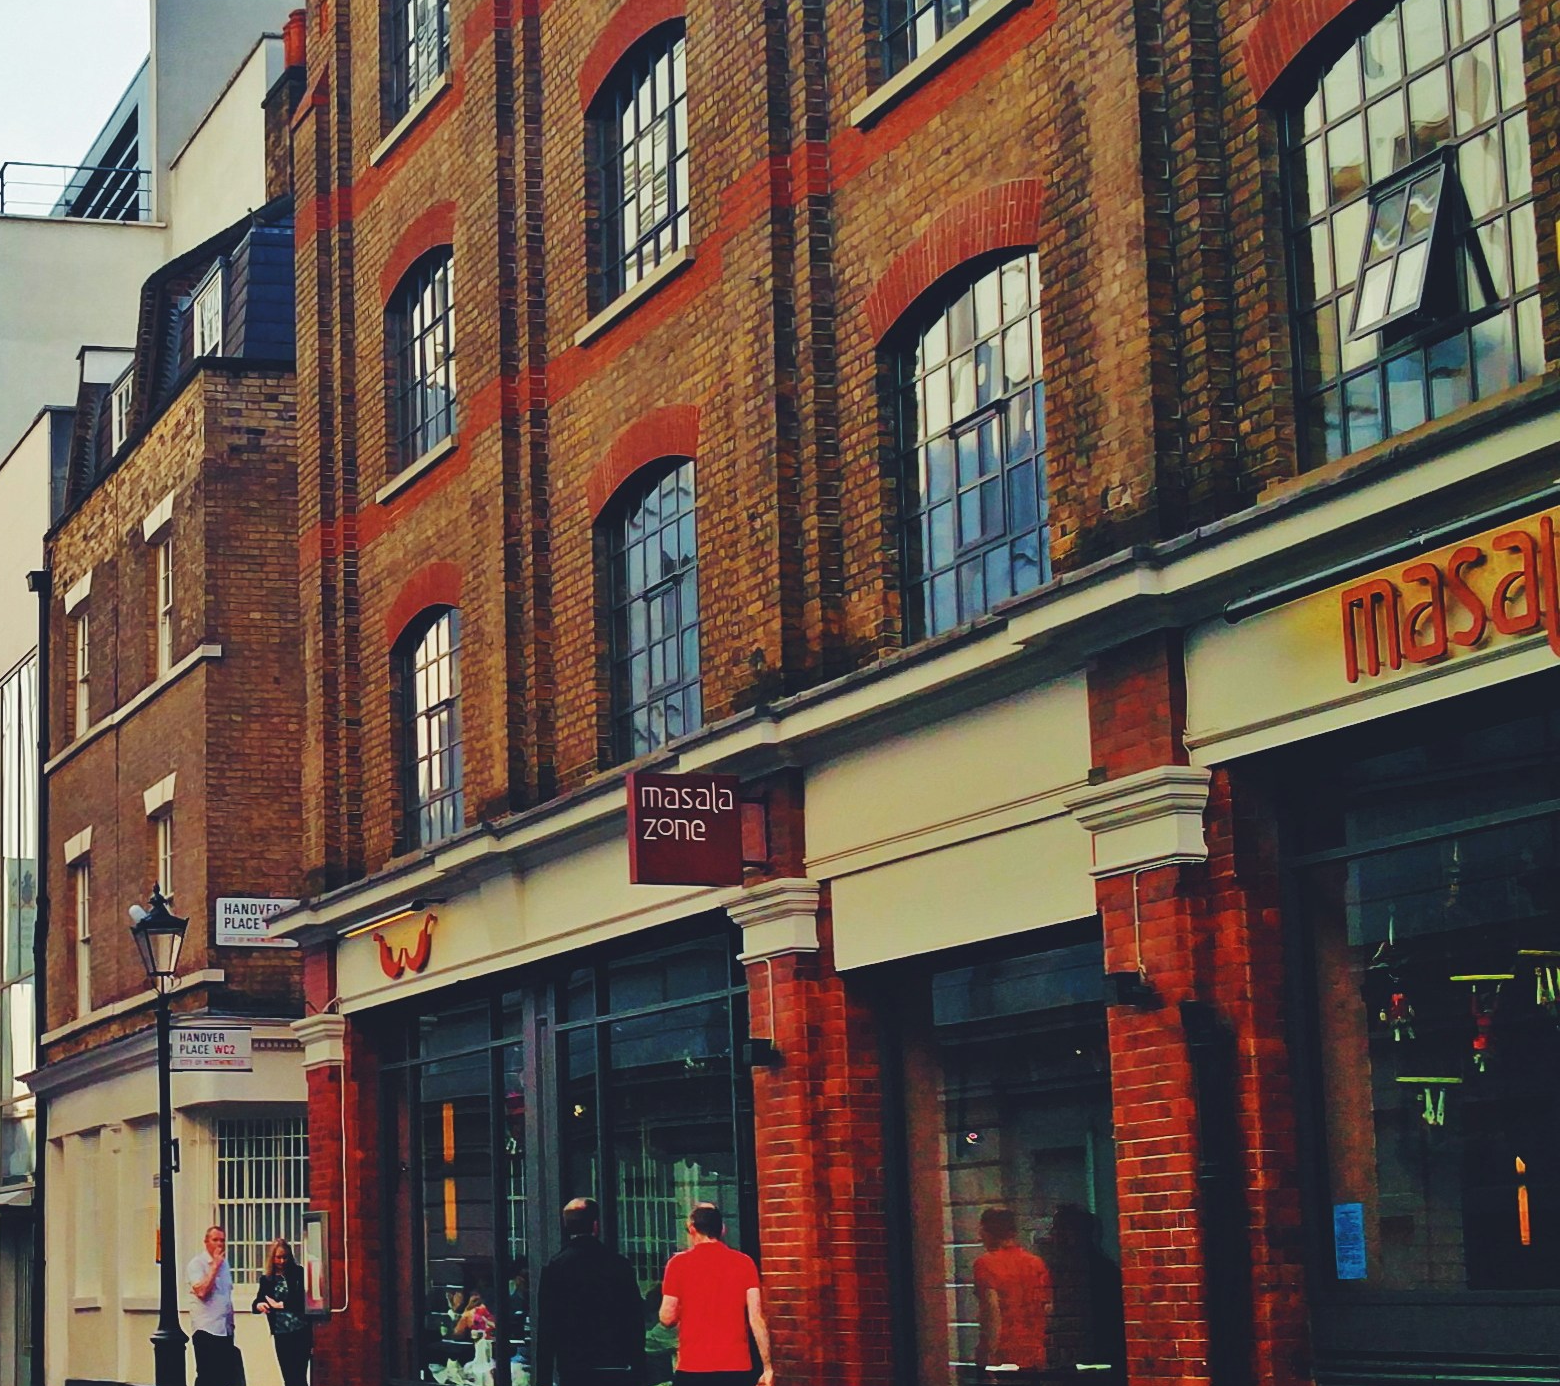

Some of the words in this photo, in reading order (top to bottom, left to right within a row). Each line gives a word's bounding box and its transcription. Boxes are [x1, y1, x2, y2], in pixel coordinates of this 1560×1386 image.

[1341, 516, 1560, 683] masal
[642, 782, 733, 813] masala
[643, 819, 706, 841] zone
[224, 918, 260, 929] PLACE
[180, 1033, 225, 1042] HANOVER
[180, 1045, 210, 1054] PLACE
[214, 1045, 236, 1054] WC2
